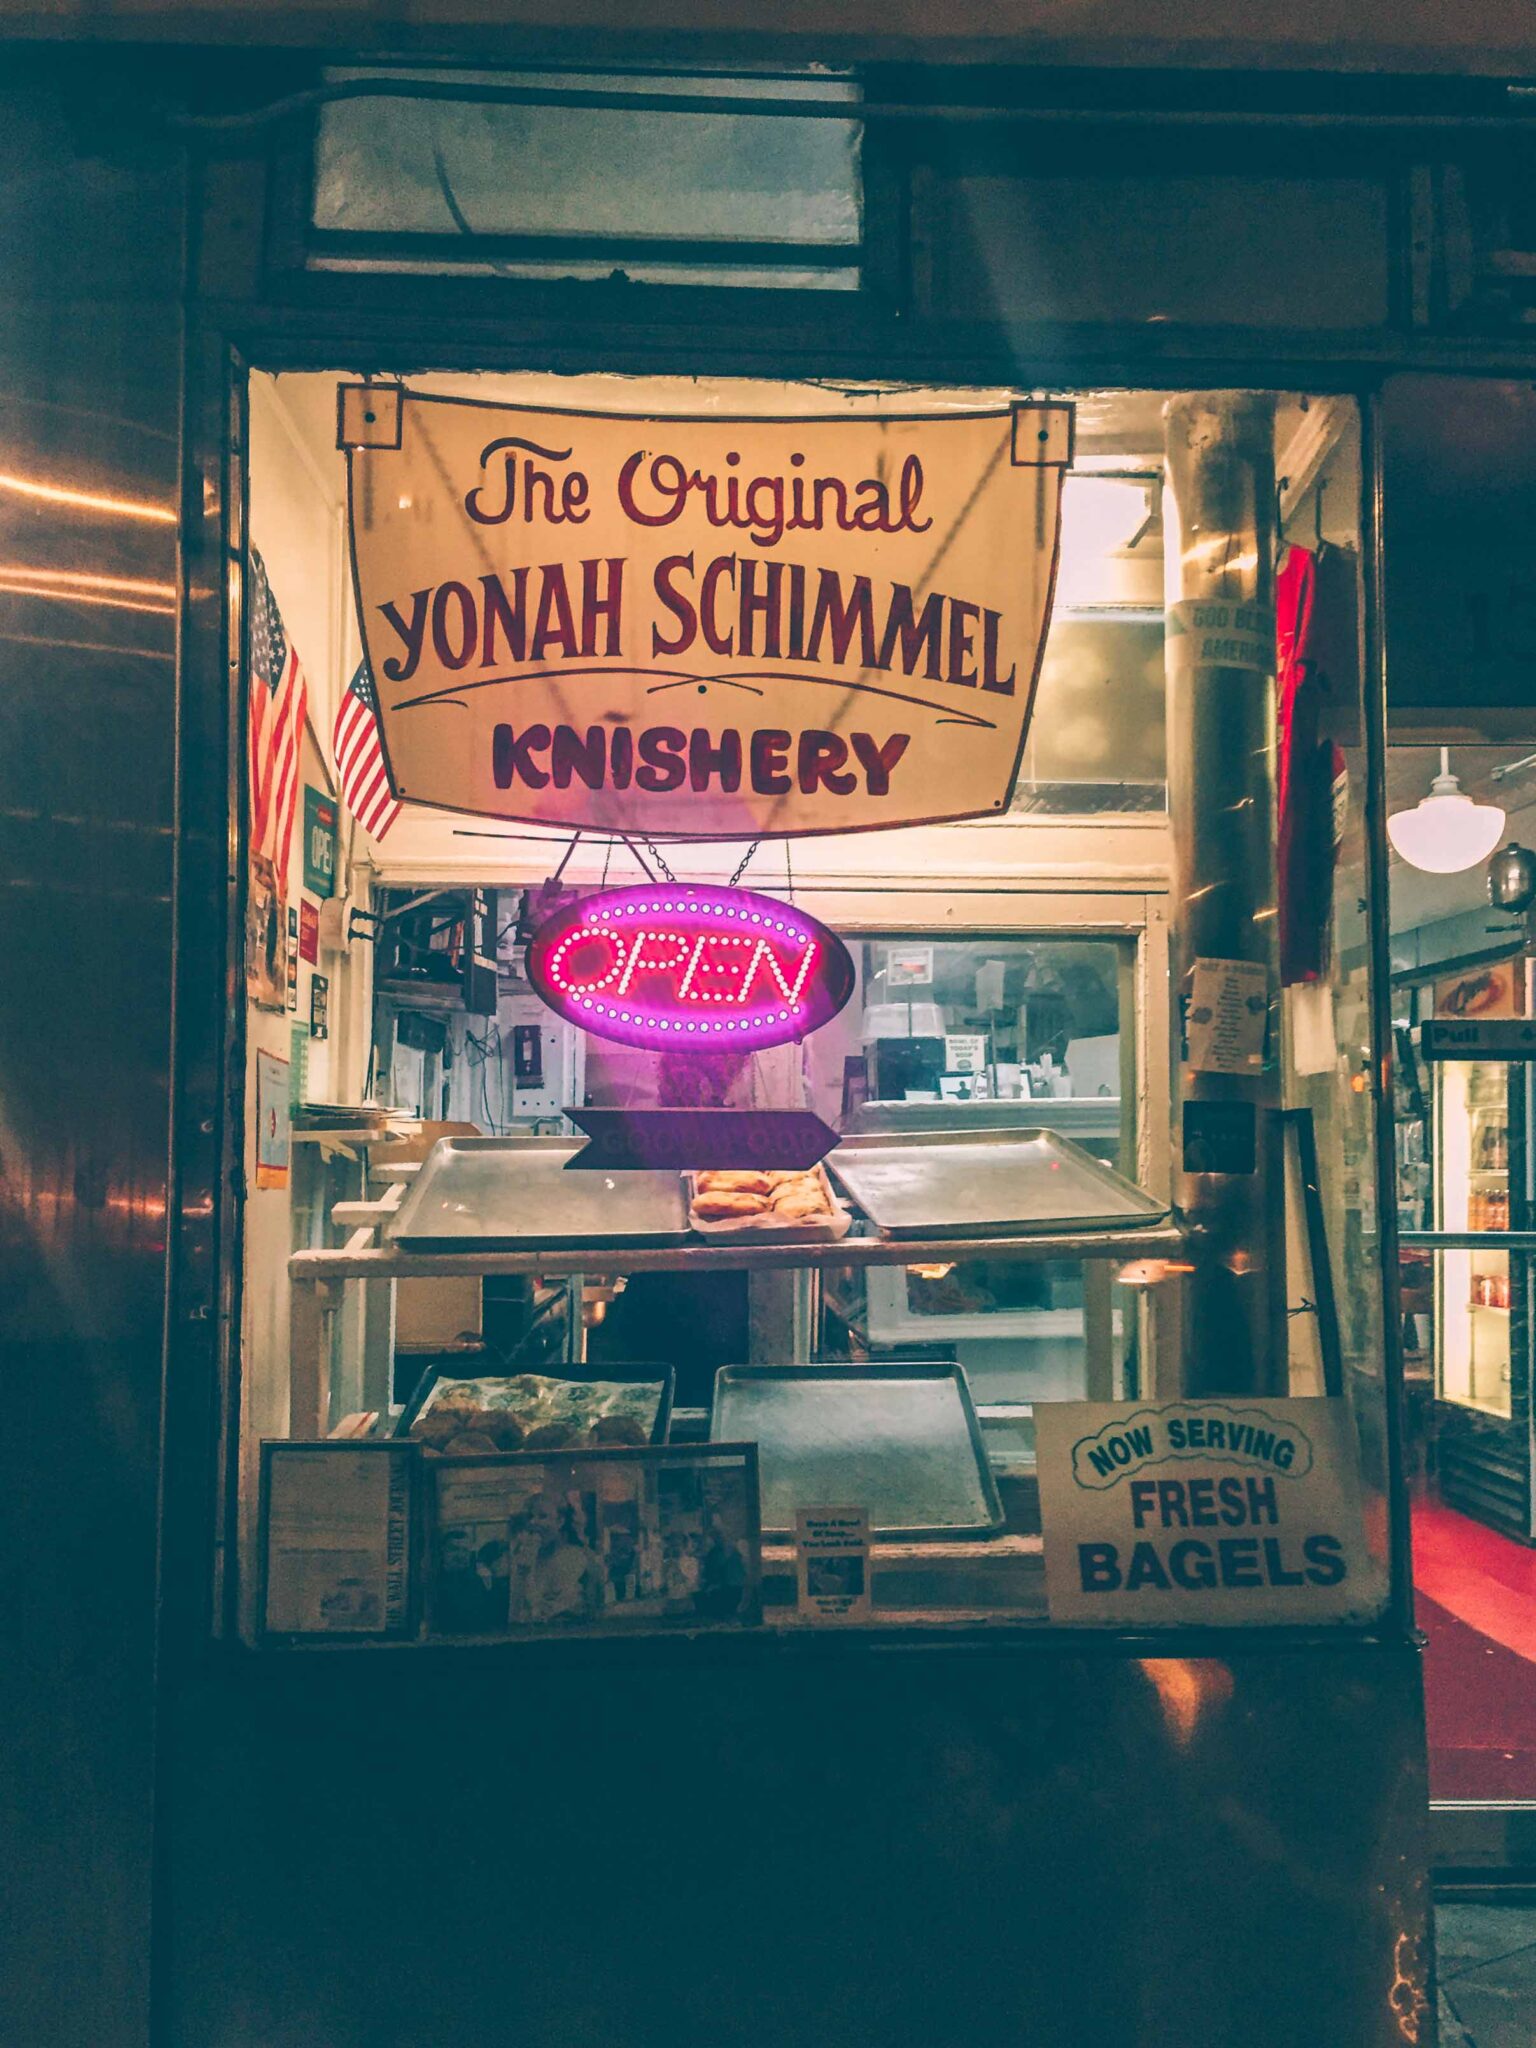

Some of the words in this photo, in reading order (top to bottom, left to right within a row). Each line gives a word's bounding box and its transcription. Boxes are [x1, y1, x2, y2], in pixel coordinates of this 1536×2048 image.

[465, 437, 592, 526] The
[617, 452, 934, 547] Original
[376, 557, 628, 682] YONAH
[652, 551, 1017, 697] SCHIMMEL
[1193, 606, 1229, 629] GOD
[491, 722, 911, 797] KNISHERY
[550, 927, 818, 1005] OPEN
[1433, 1027, 1479, 1043] Pull
[1088, 1426, 1154, 1477] NOW
[1168, 1419, 1296, 1470] SERVING
[1130, 1477, 1280, 1529] FRESH
[387, 1519, 404, 1566] STREET
[1078, 1534, 1347, 1593] BAGELS
